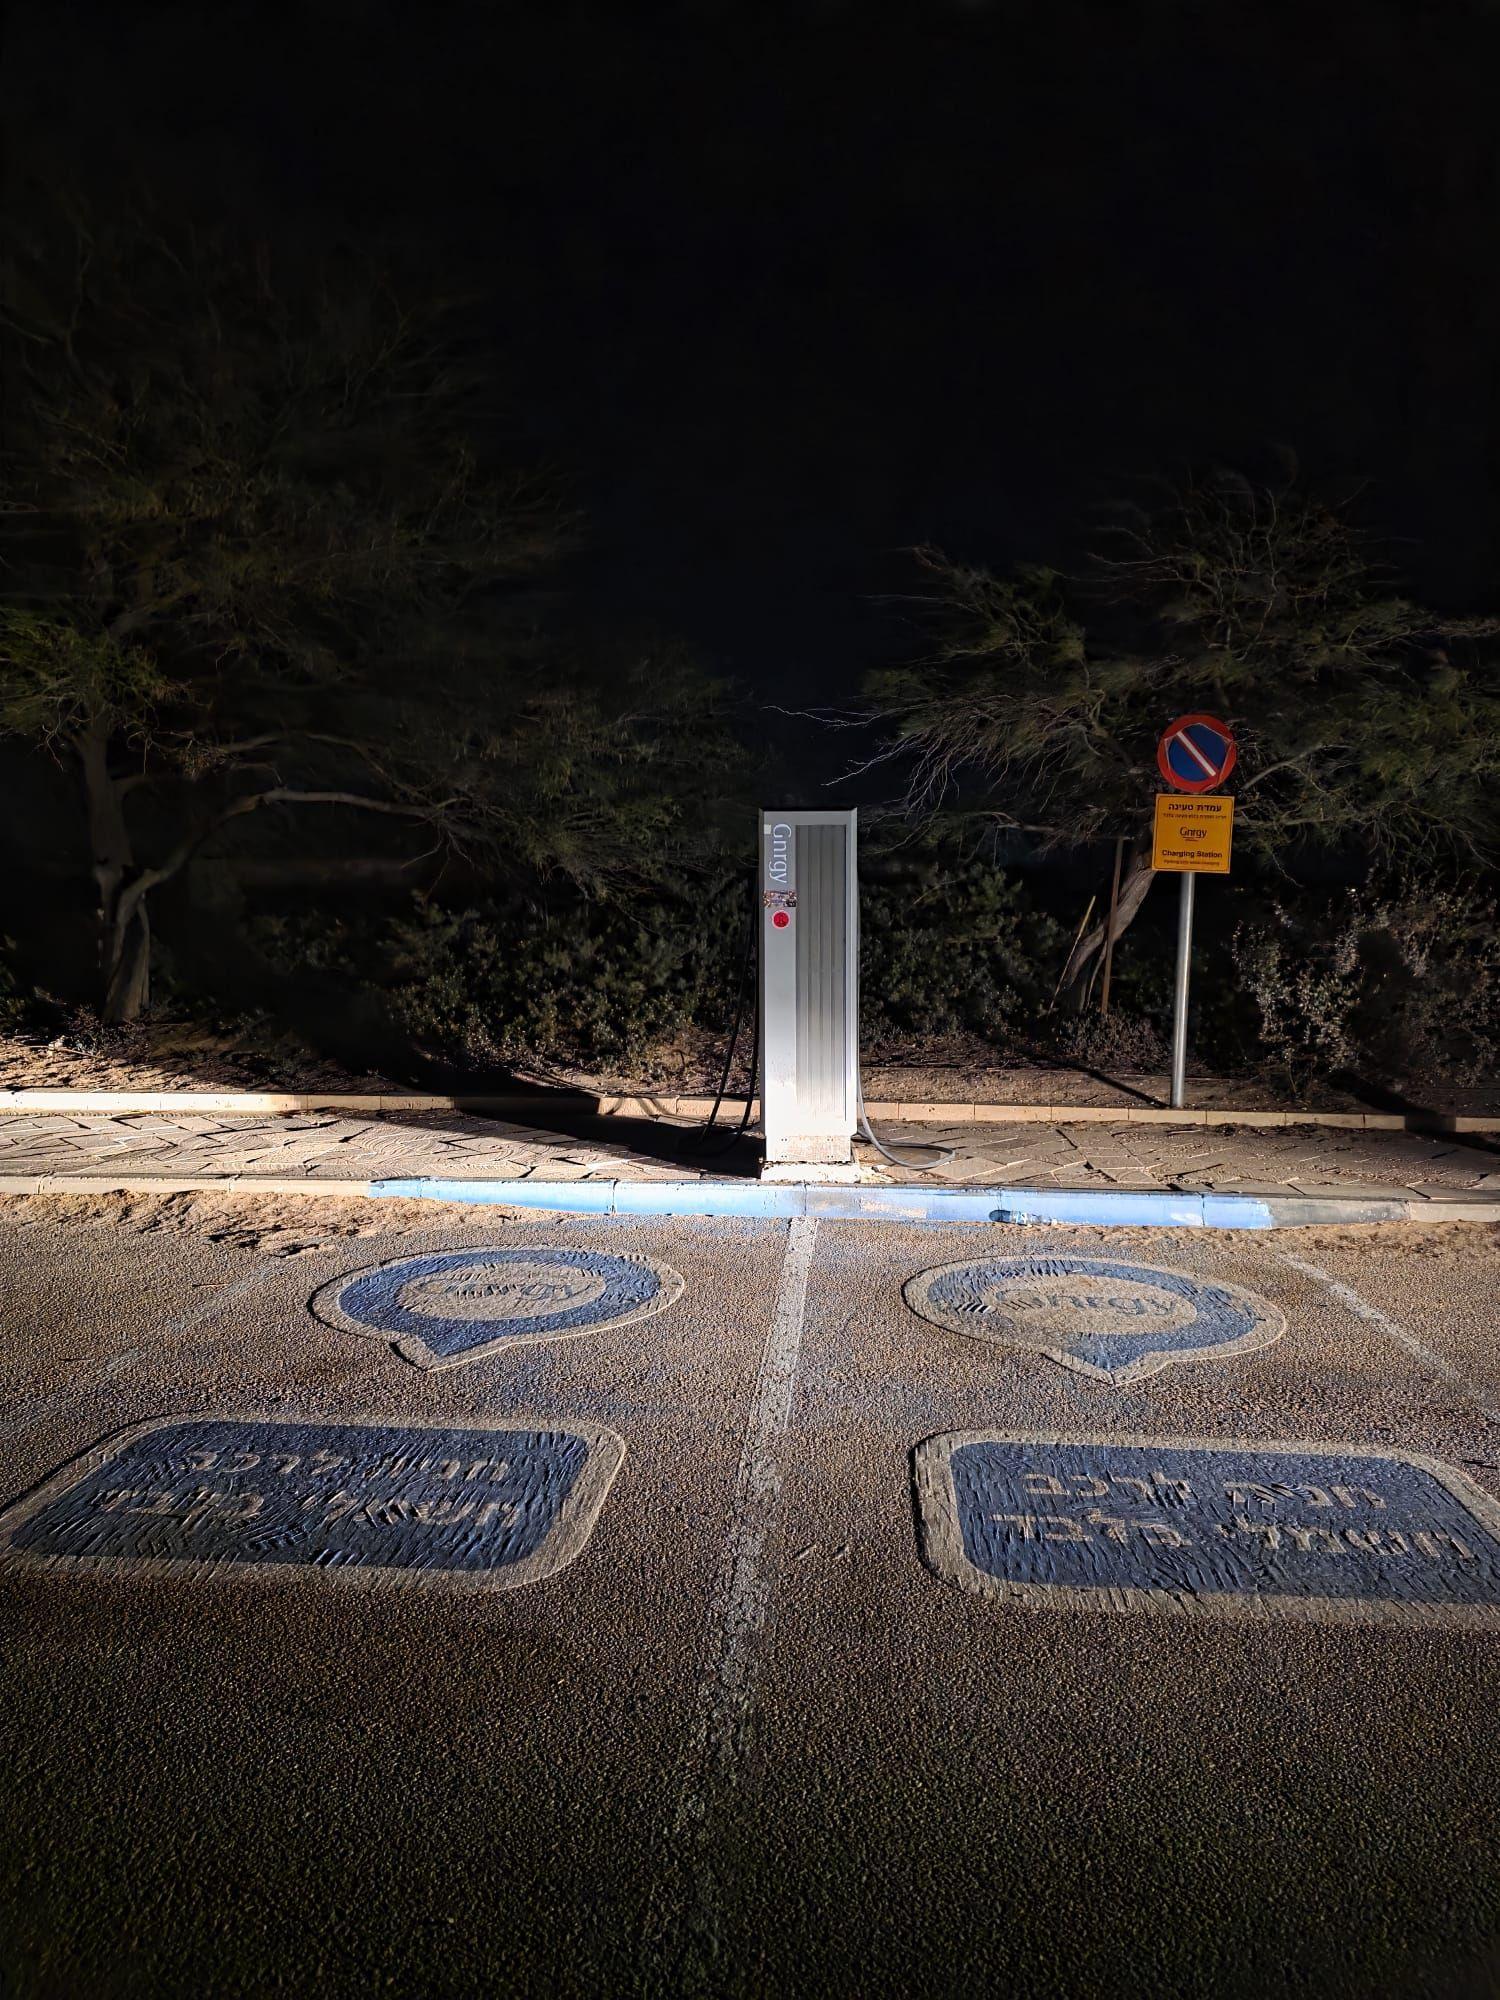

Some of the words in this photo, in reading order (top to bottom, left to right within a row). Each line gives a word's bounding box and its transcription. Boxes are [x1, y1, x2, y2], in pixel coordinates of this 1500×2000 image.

[1168, 803, 1194, 811] טעינה
[769, 823, 792, 883] Gnrgy
[1162, 849, 1195, 858] Charging
[1197, 850, 1223, 858] Station
